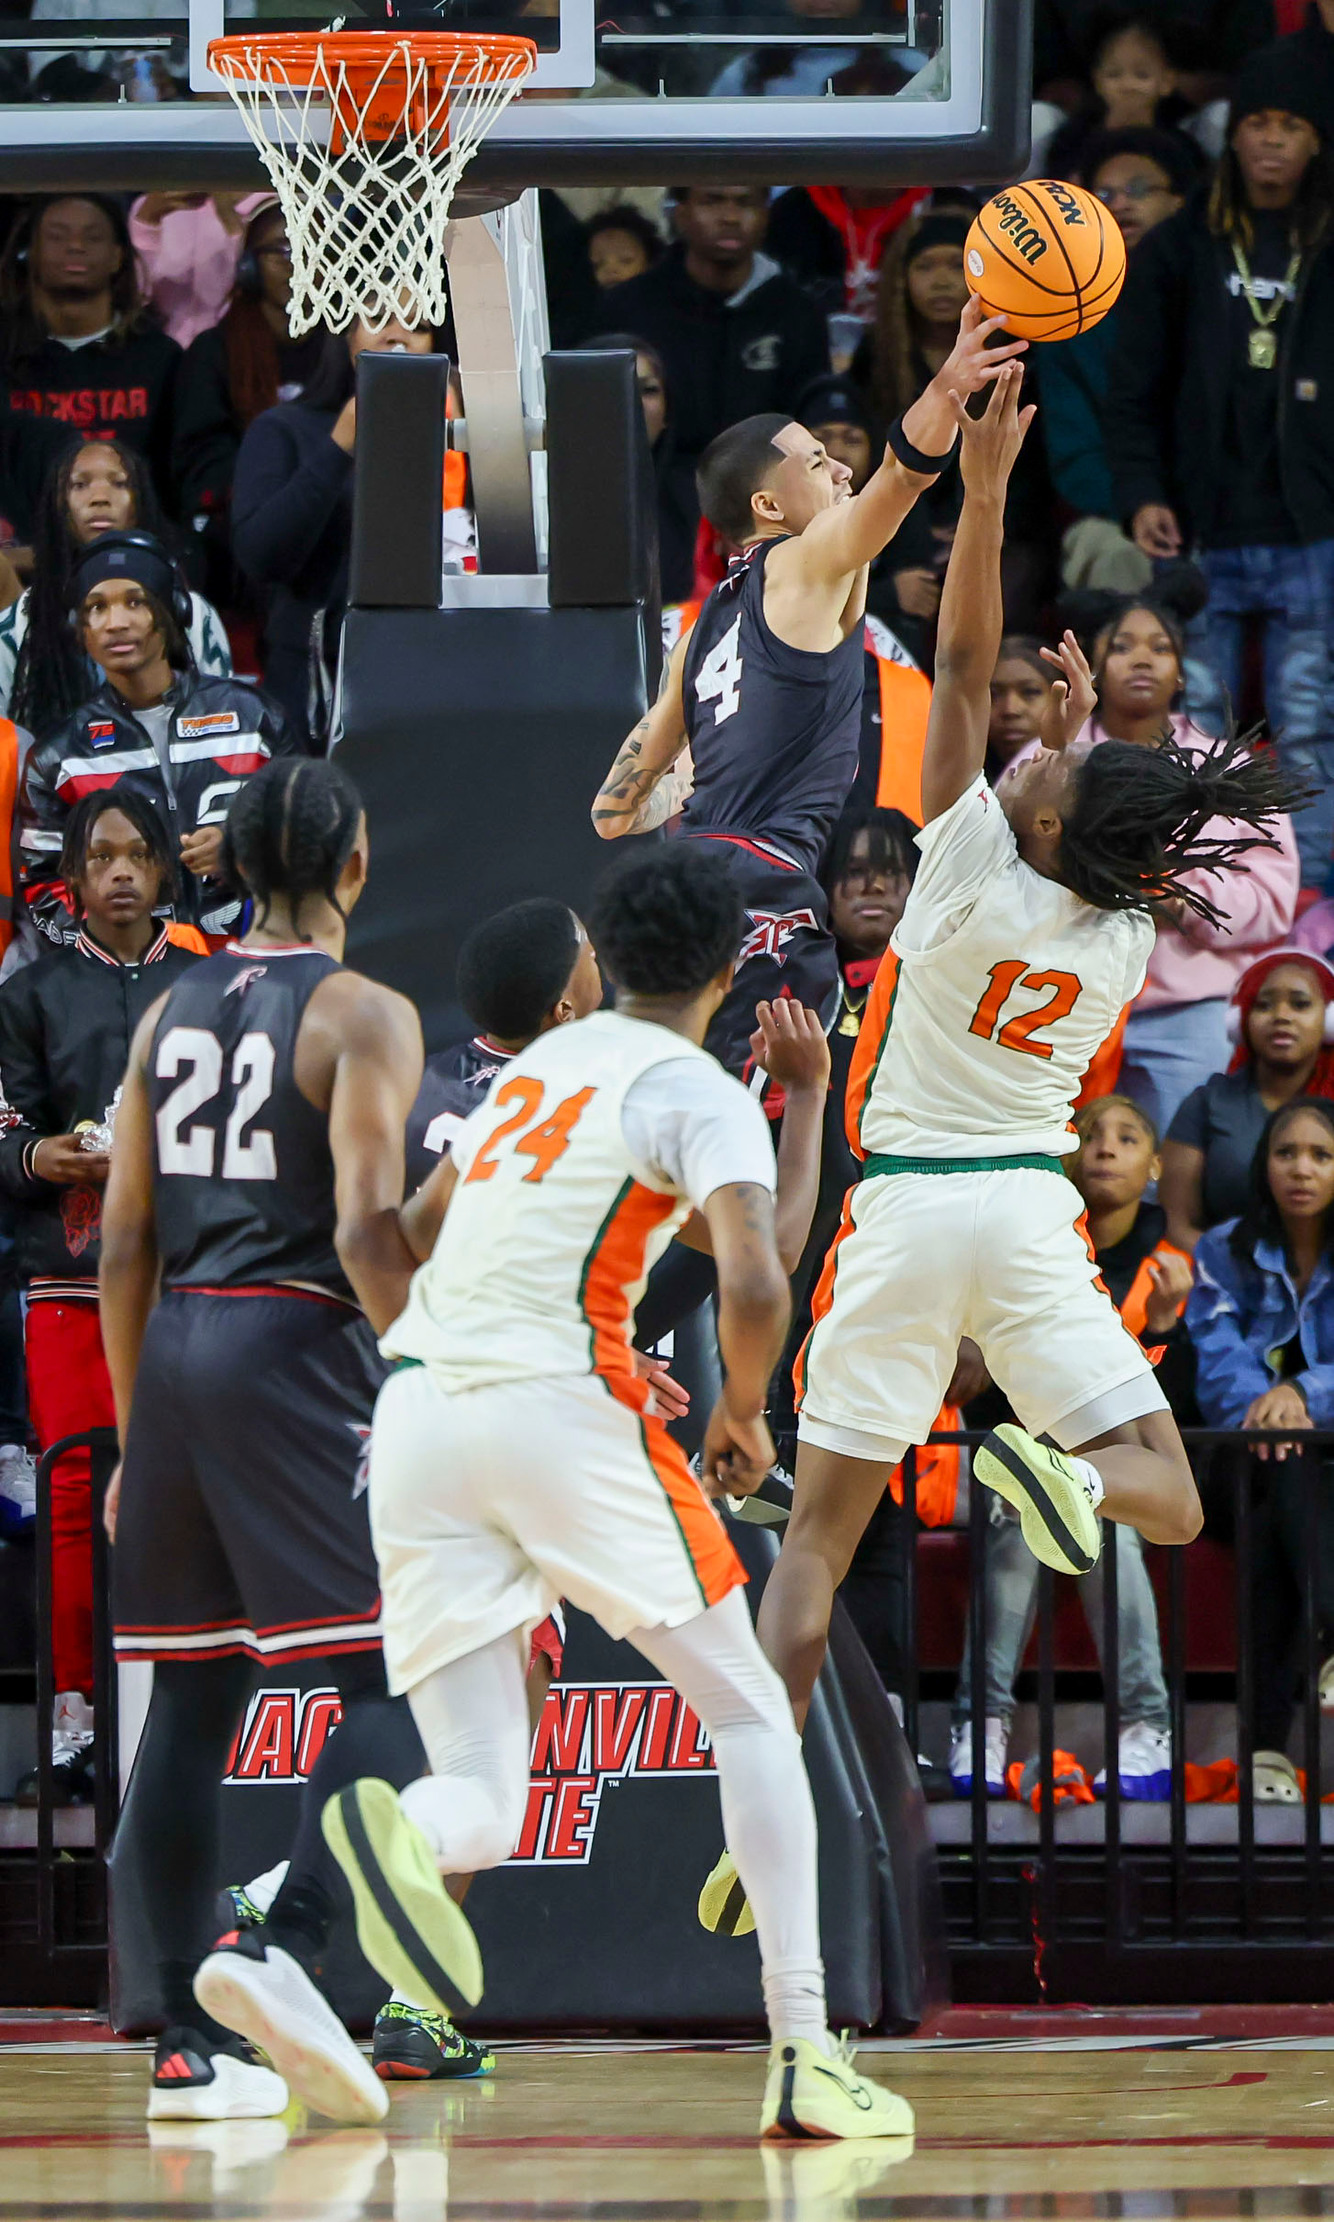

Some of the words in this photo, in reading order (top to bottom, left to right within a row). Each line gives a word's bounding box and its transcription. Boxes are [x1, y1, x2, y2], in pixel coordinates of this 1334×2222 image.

[990, 191, 1048, 267] Wilson
[695, 612, 743, 726] 4
[968, 960, 1083, 1060] 12
[156, 1027, 277, 1181] 22
[464, 1076, 598, 1184] 24
